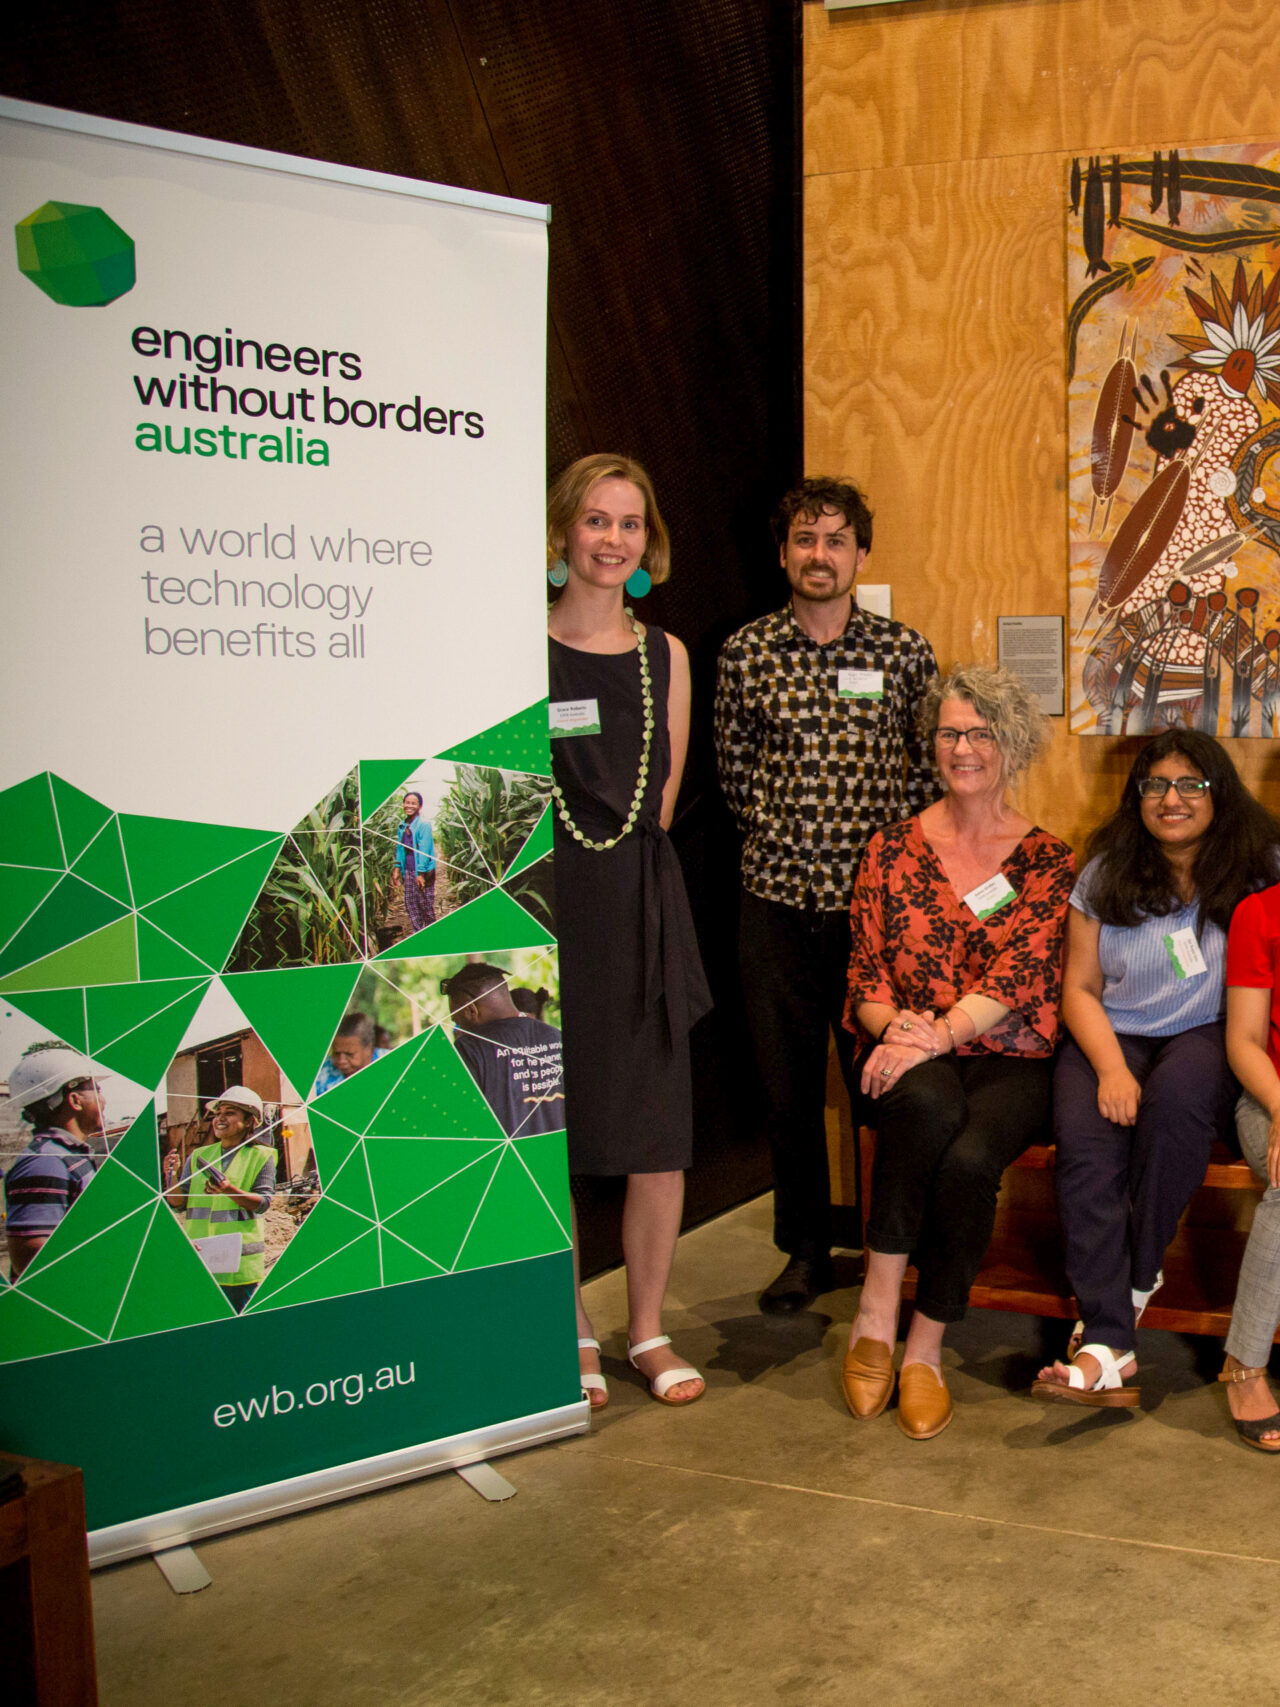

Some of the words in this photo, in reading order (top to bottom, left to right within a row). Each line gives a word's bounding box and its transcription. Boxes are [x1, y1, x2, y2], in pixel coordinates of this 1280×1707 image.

[131, 325, 362, 381] engineers
[133, 372, 315, 423] without
[323, 386, 485, 439] borders
[134, 421, 330, 467] australia
[140, 524, 165, 553] a
[179, 522, 296, 560] world
[310, 527, 432, 566] where
[141, 569, 373, 621] technology
[144, 617, 317, 658] benefits
[328, 623, 365, 659] all
[496, 1048, 510, 1058] An
[511, 1058, 524, 1067] for
[513, 1069, 530, 1080] and
[522, 1082, 530, 1092] is
[213, 1361, 416, 1428] ewb.org.au
